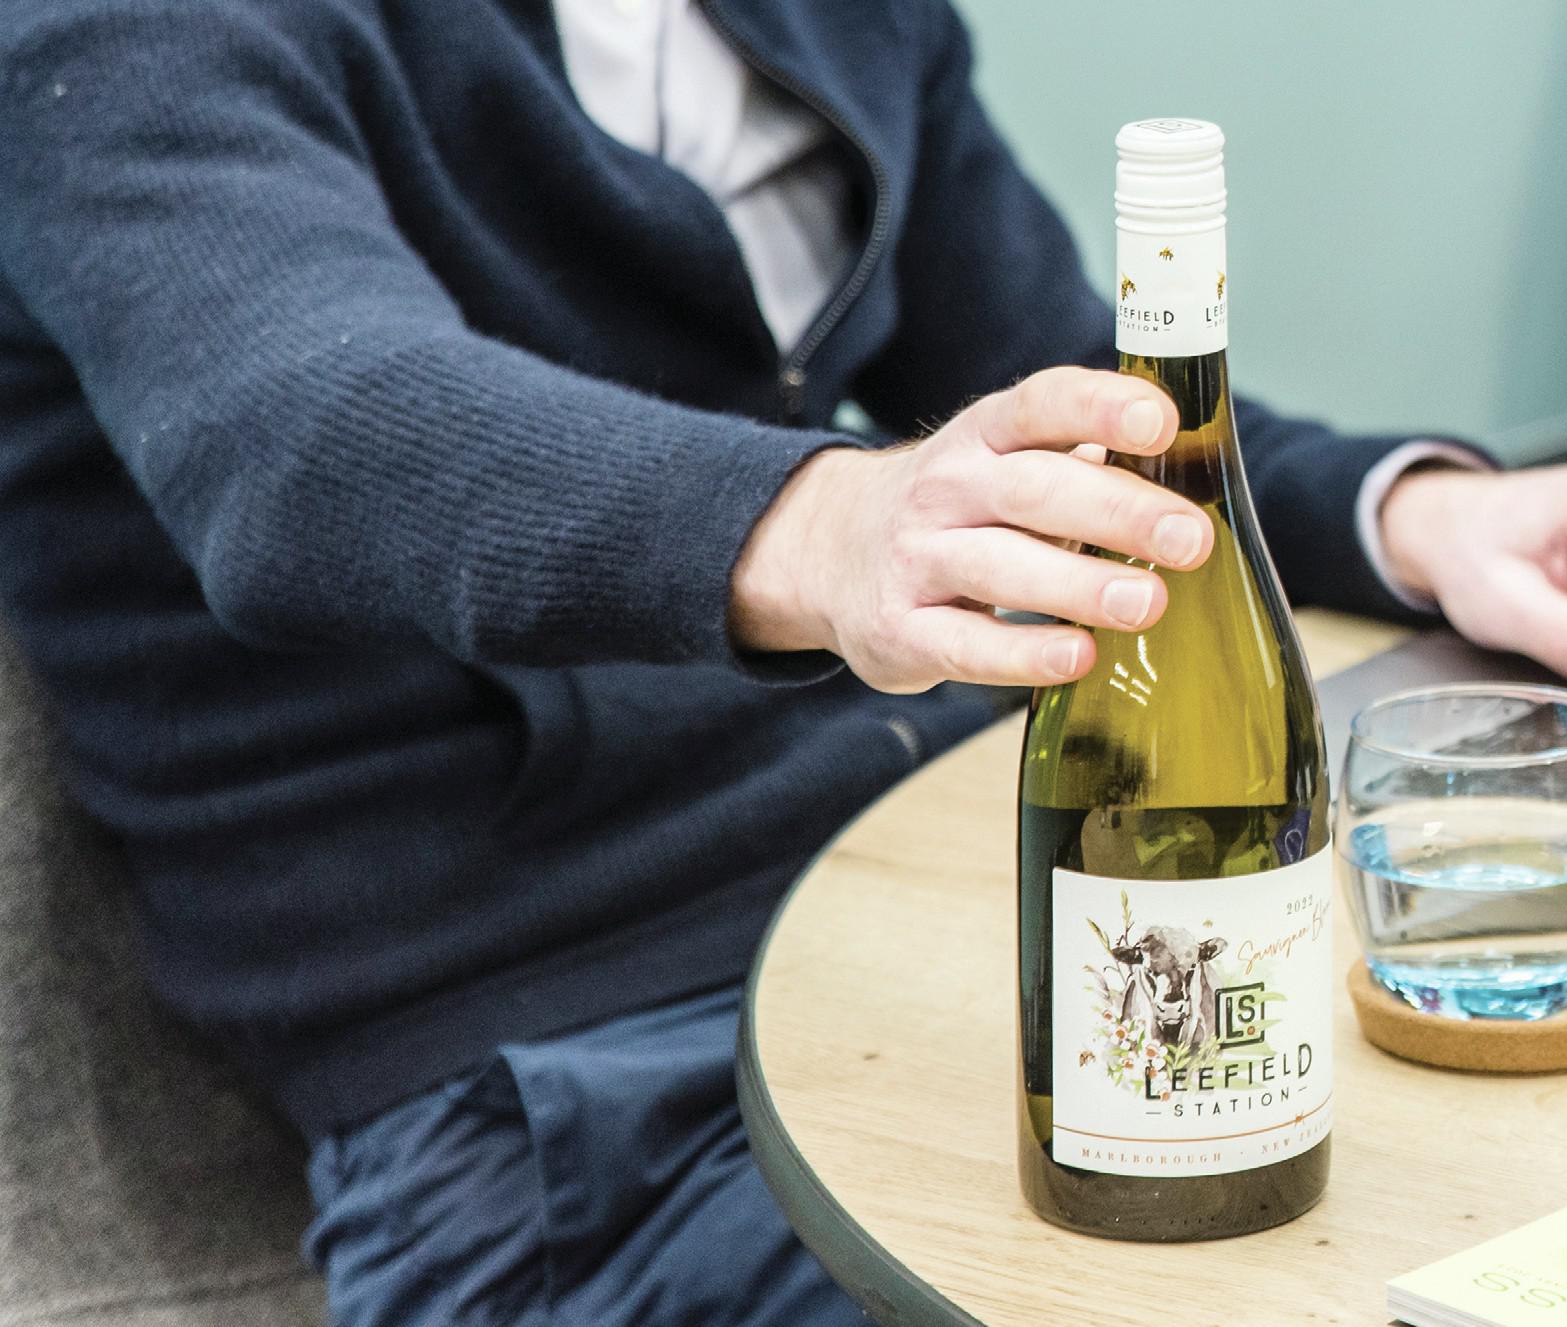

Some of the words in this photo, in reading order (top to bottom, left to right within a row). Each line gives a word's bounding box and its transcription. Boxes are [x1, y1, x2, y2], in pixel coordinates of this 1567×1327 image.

[1117, 305, 1174, 325] EEFIELD
[1145, 1043, 1312, 1101] LEEFIELD
[1174, 1088, 1289, 1117] STATION
[1082, 1147, 1222, 1165] MARLBOROUGH
[1261, 1138, 1290, 1155] NEW
